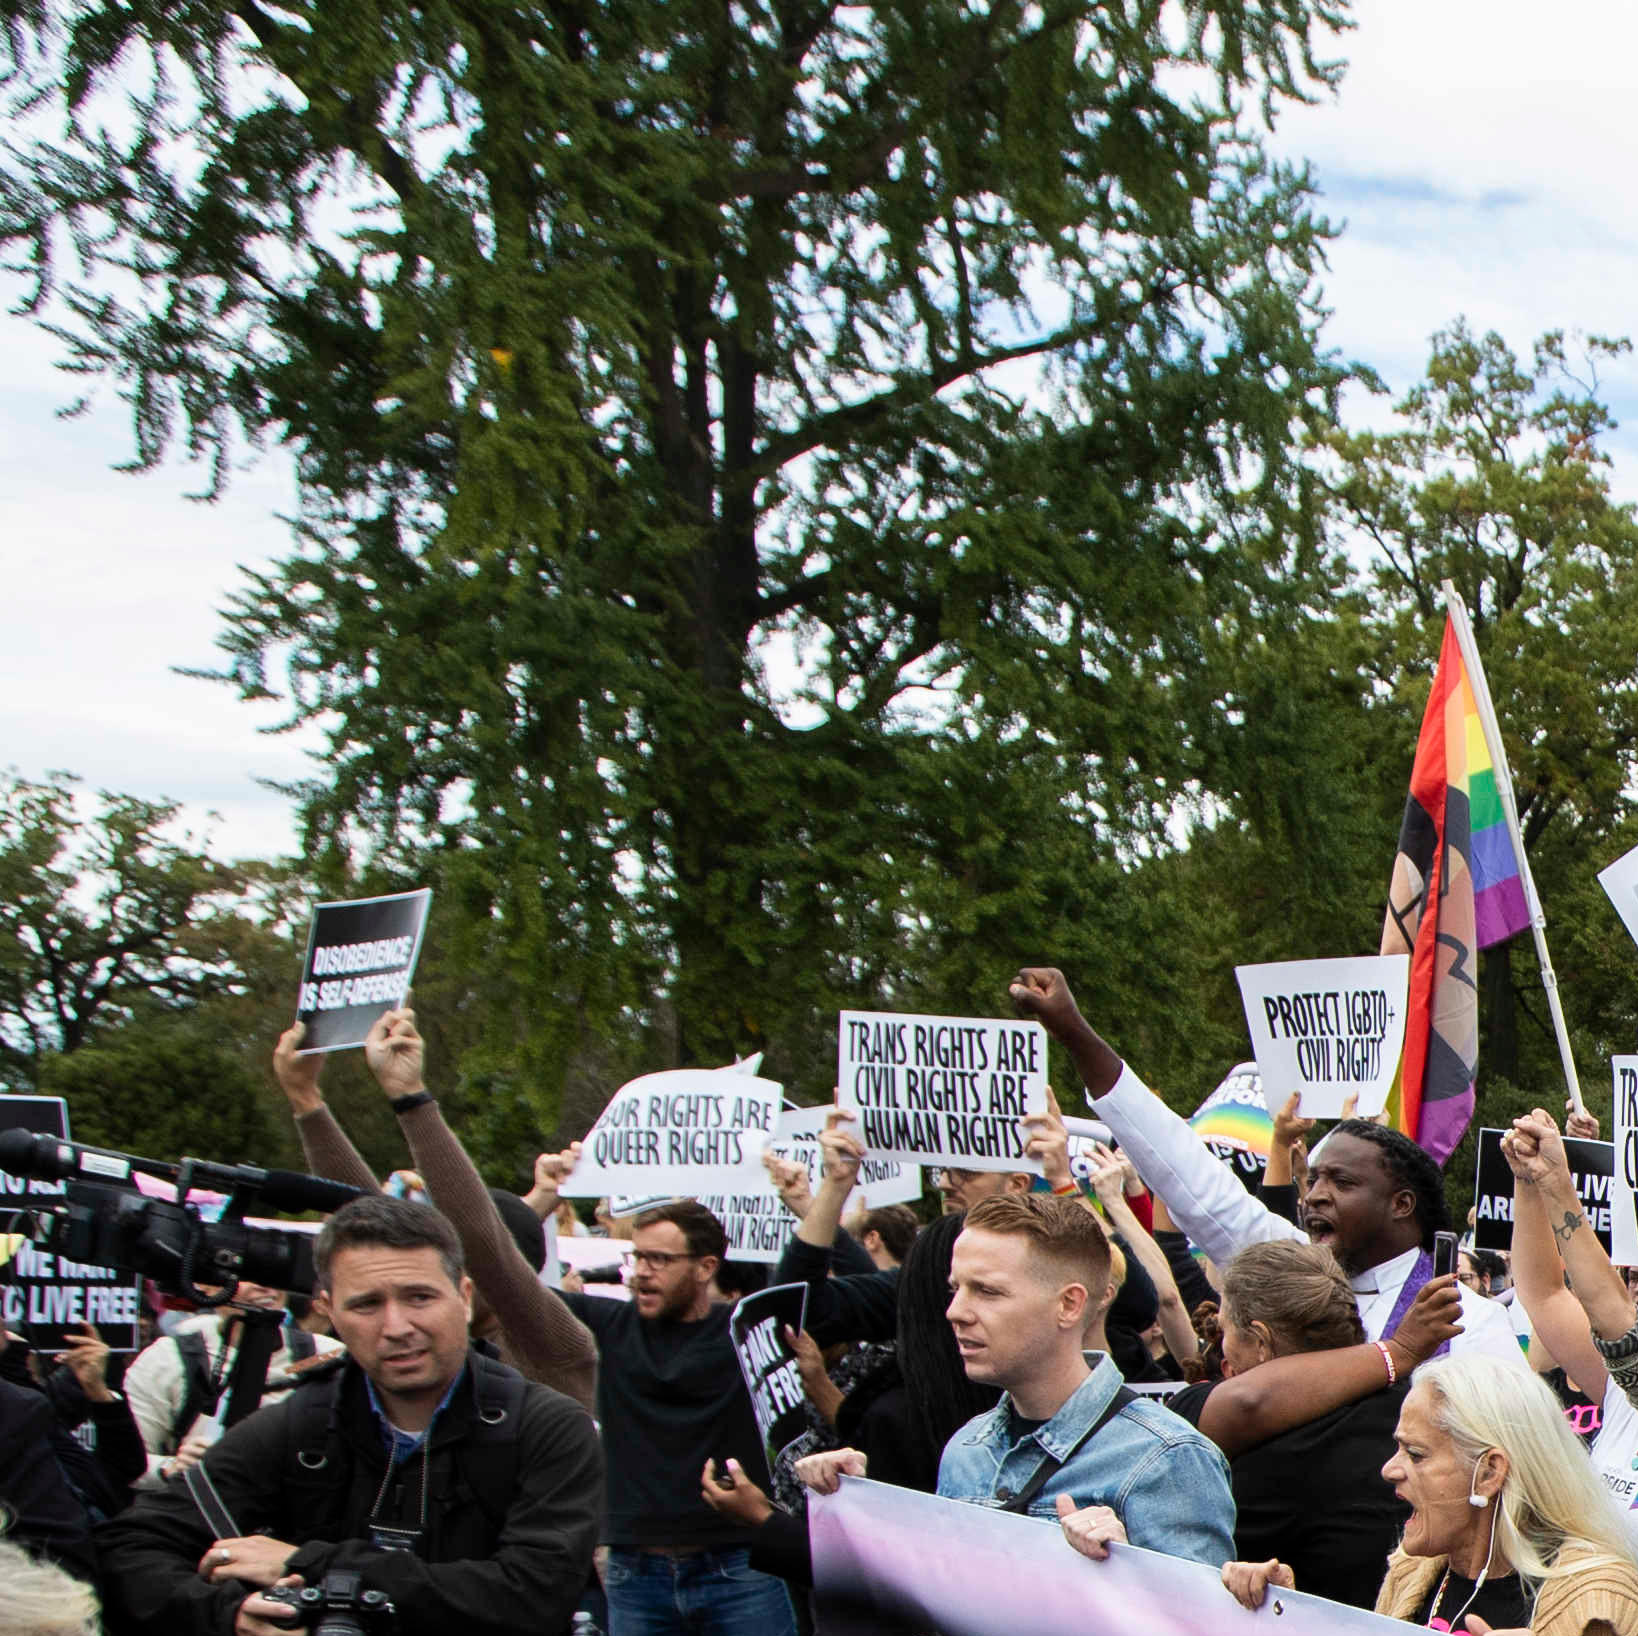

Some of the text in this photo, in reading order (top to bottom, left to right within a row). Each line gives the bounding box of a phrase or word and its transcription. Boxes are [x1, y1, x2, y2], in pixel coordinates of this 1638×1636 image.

[299, 982, 318, 1011] IS
[1263, 990, 1395, 1040] PROTECT LGBTQ+
[848, 1020, 1038, 1073] TRANS RIGHTS ARE
[1296, 1037, 1384, 1082] CIVIL RIGHTS
[856, 1065, 1028, 1116] CIVIL RIGHTS ARE
[648, 1095, 724, 1128] RIGHTS
[730, 1096, 772, 1132] ARE
[863, 1108, 943, 1154] HUMAN
[947, 1114, 1023, 1159] RIGHTS
[594, 1130, 743, 1168] QUEER RIGHTS
[29, 1286, 82, 1323] LIVE
[86, 1286, 137, 1323] FREE
